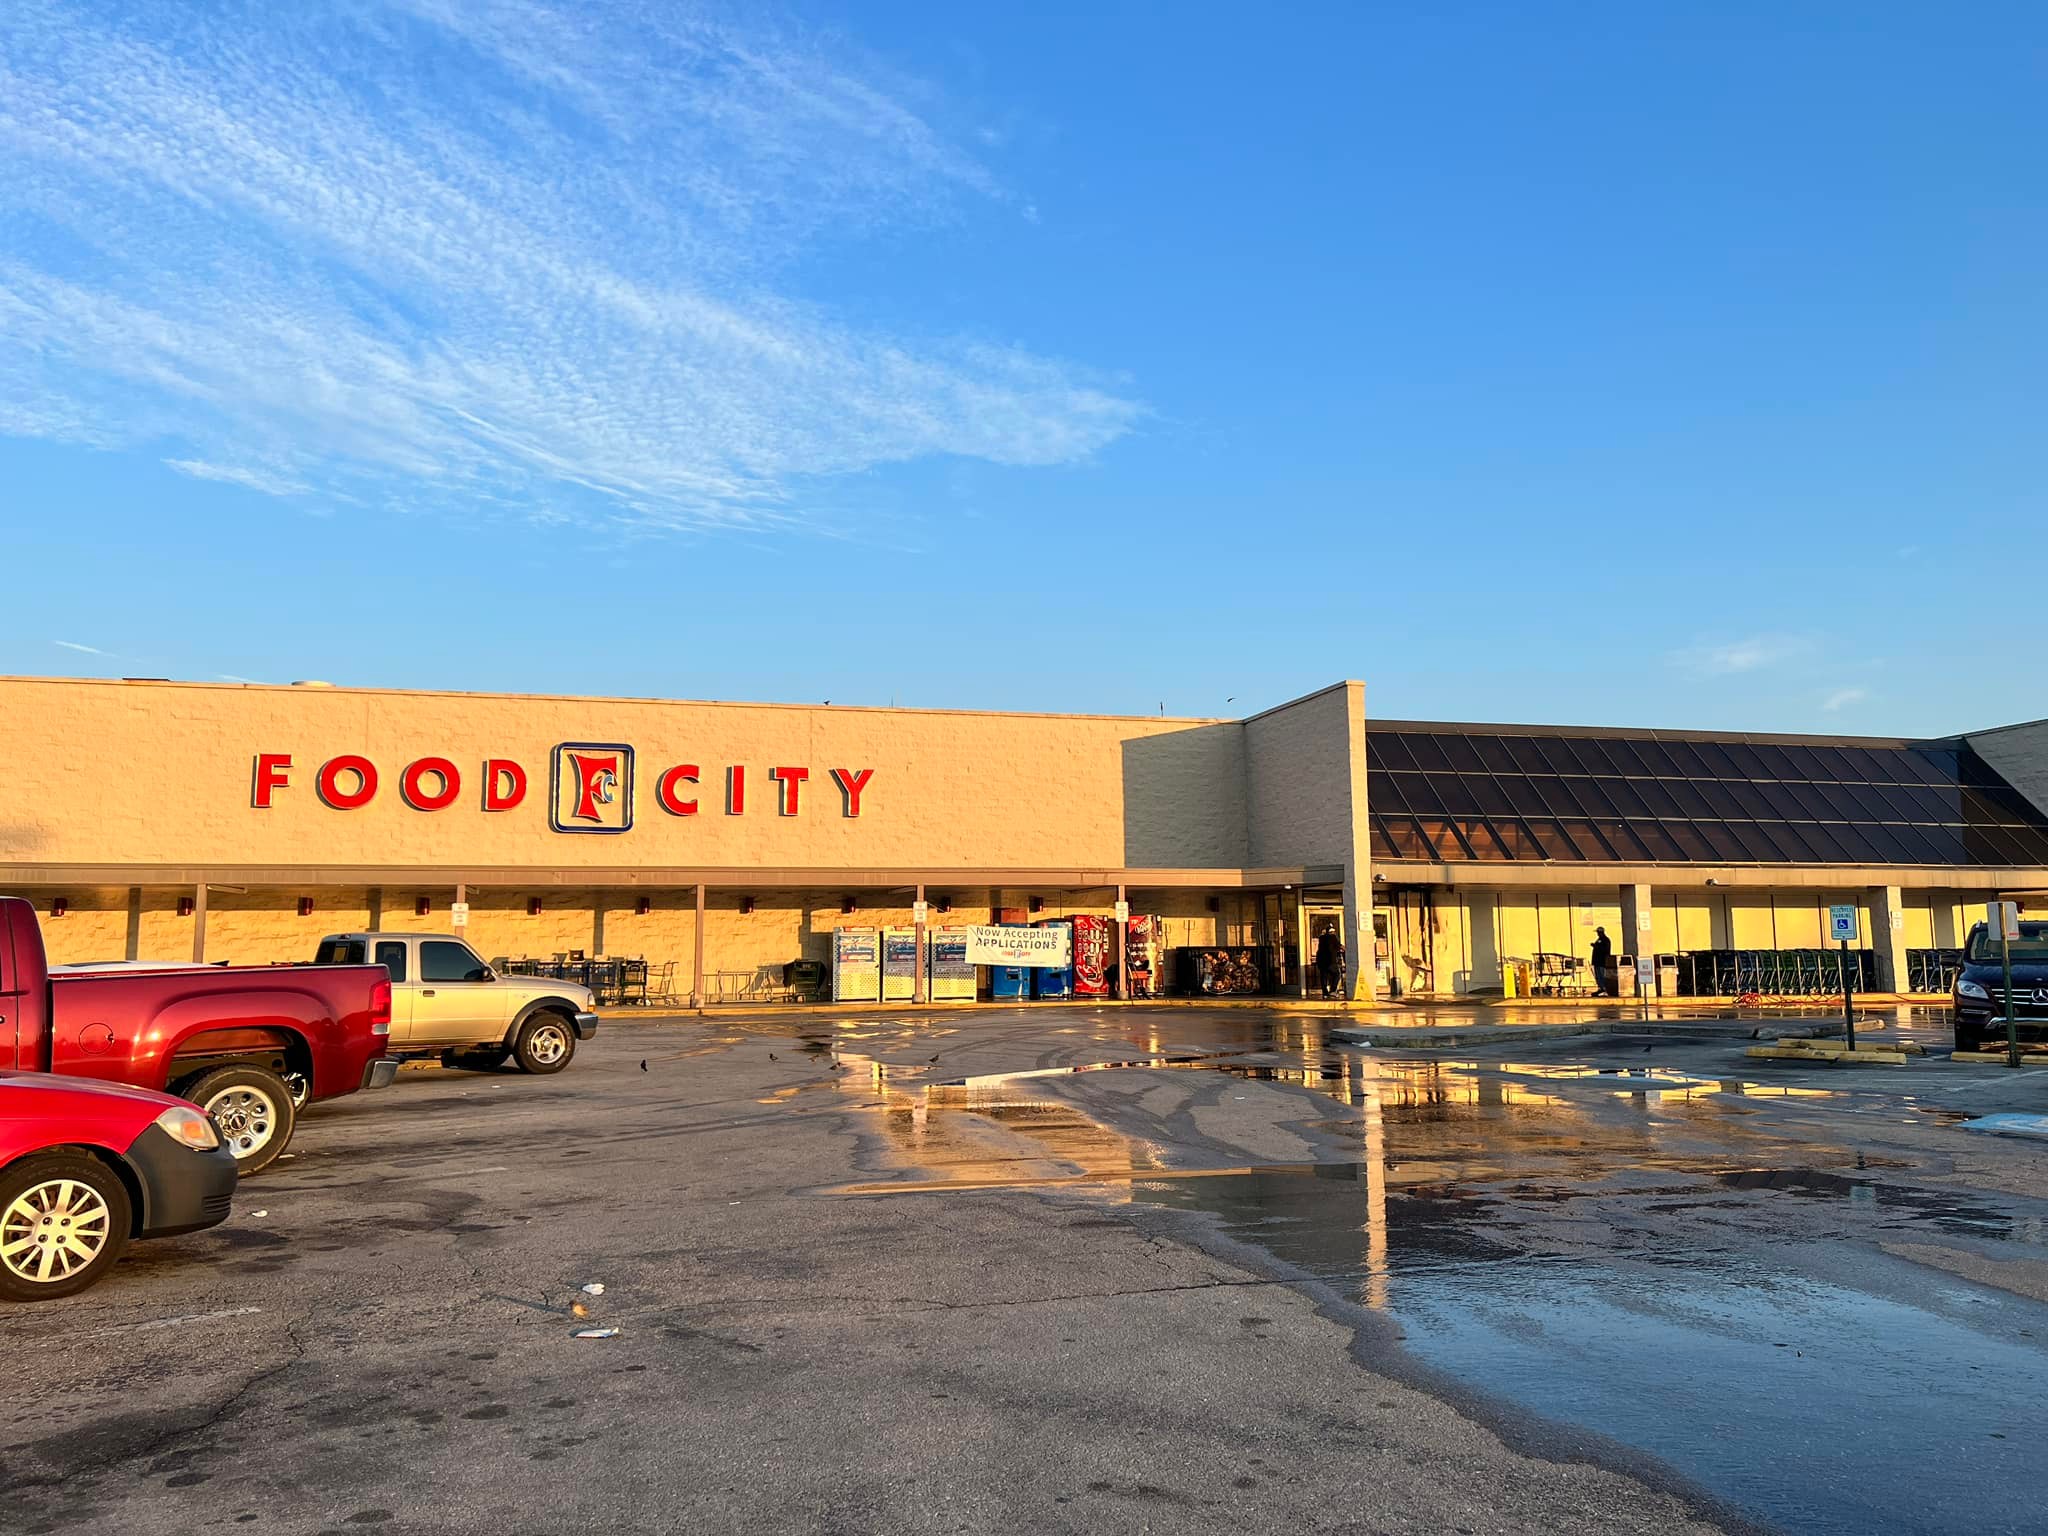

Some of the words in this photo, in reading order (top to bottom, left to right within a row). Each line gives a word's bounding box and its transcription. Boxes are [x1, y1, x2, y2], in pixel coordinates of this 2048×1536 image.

[252, 753, 528, 812] FOOD
[658, 764, 875, 818] CITY
[976, 927, 1000, 937] Now
[1004, 928, 1058, 941] Accepting
[976, 937, 1057, 950] APPLICATIONS
